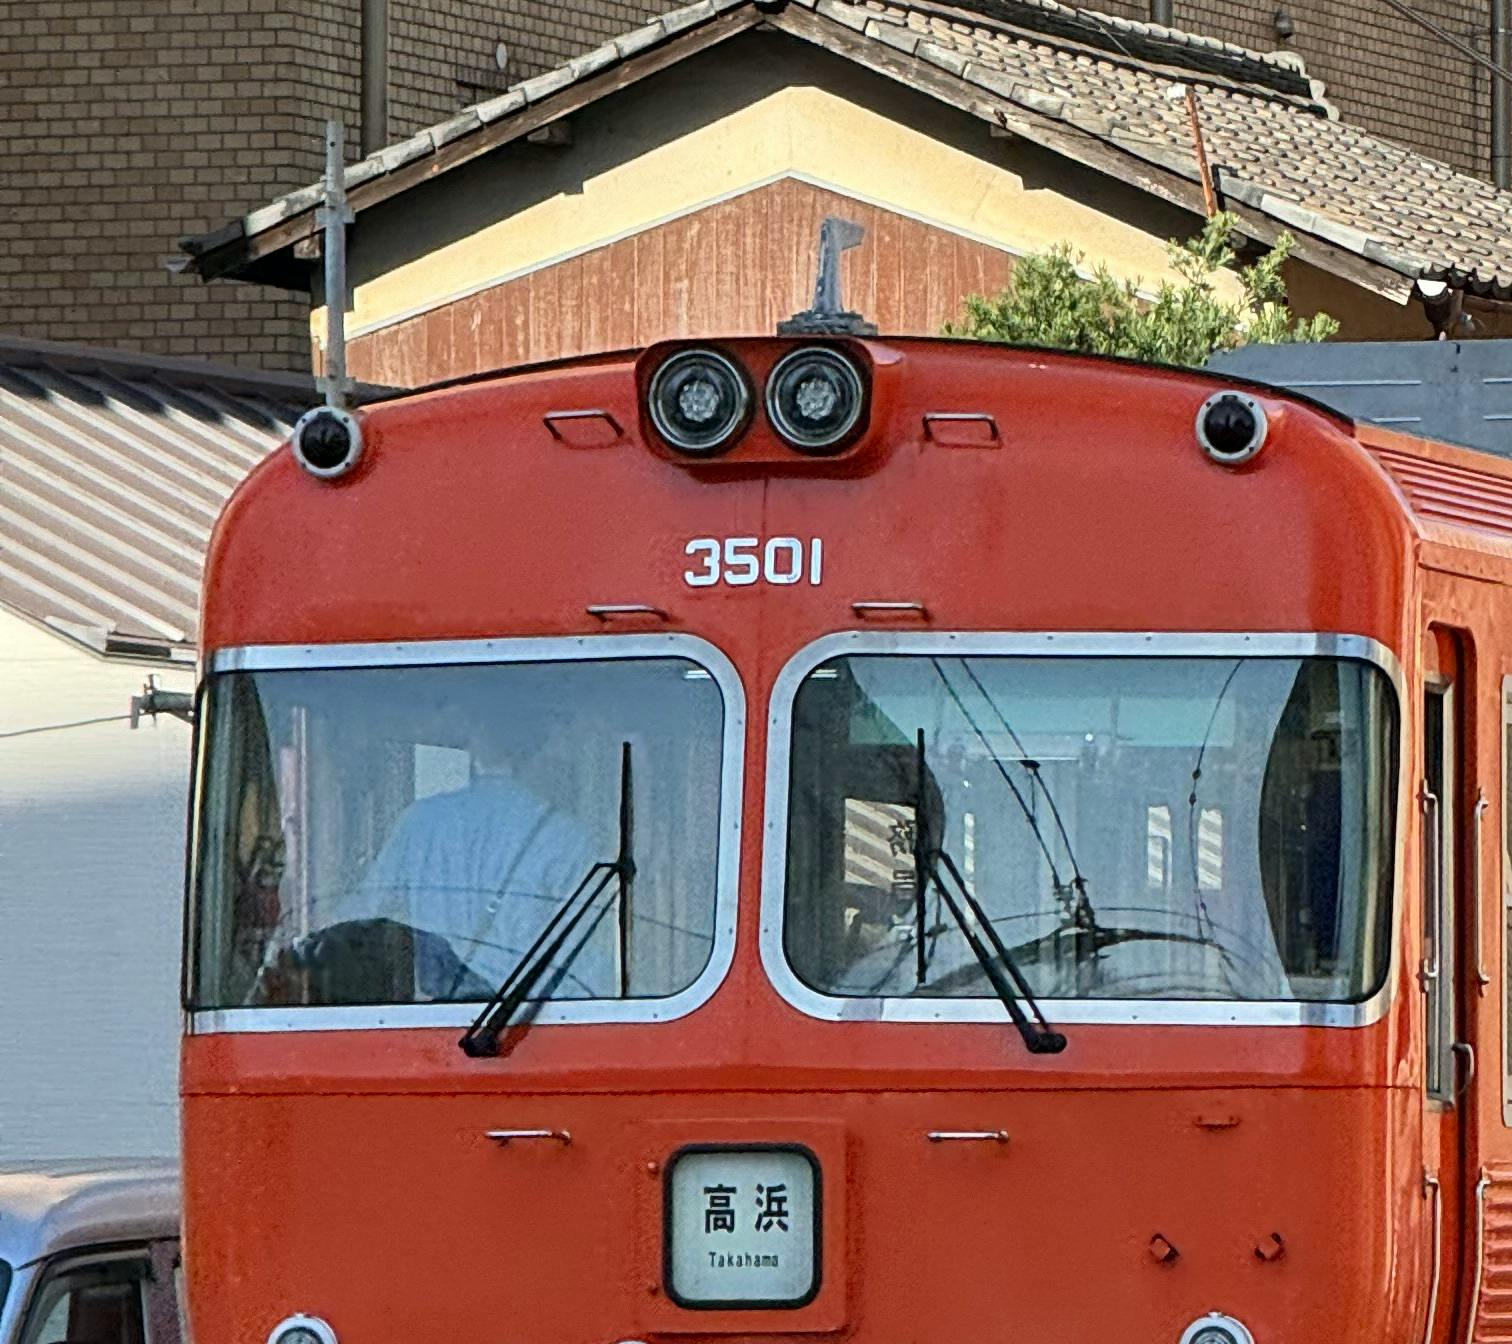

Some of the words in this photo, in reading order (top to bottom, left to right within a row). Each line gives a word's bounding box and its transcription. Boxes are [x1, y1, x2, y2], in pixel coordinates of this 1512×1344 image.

[684, 537, 823, 586] 3501
[703, 1183, 789, 1234] 高浜
[708, 1251, 779, 1268] Takahama
